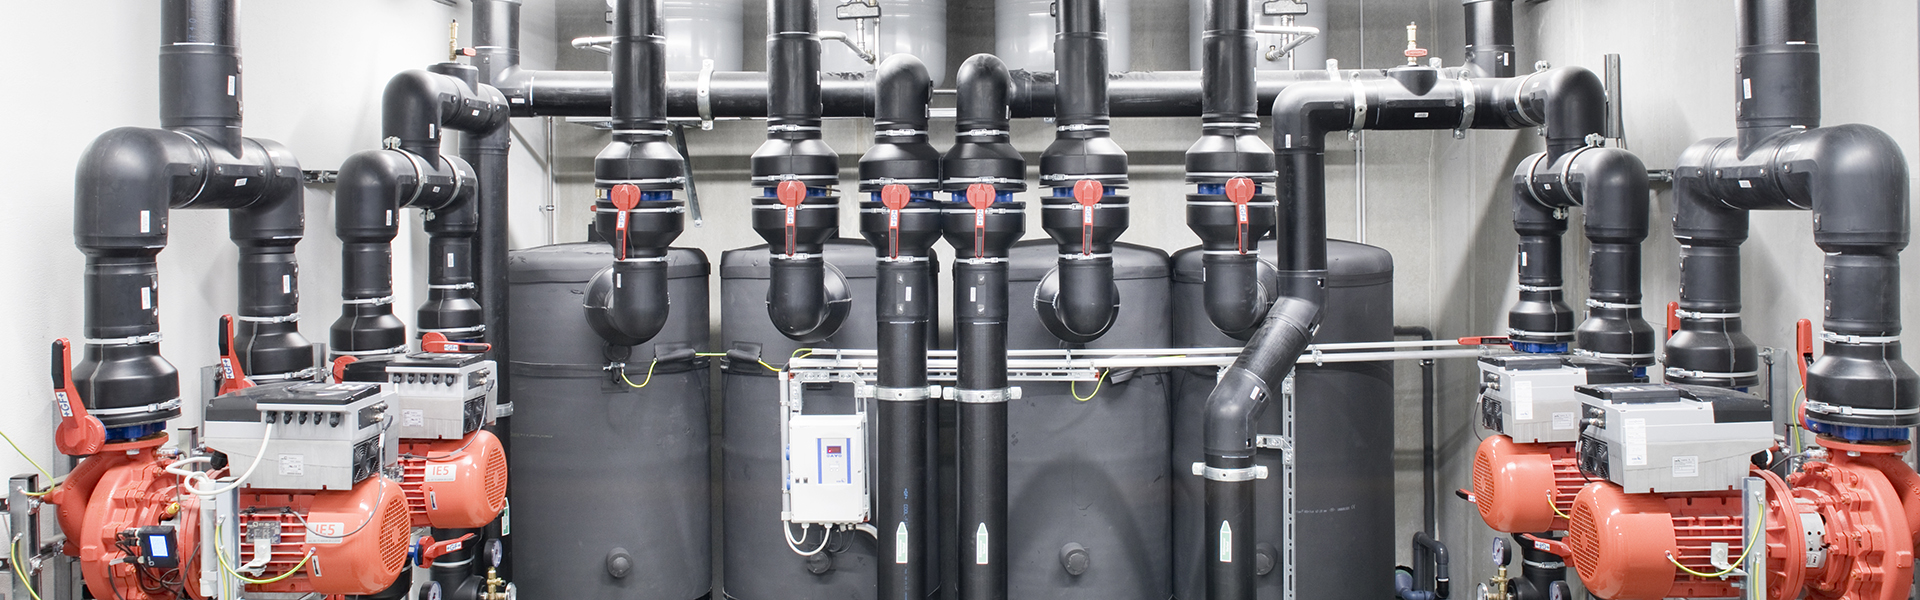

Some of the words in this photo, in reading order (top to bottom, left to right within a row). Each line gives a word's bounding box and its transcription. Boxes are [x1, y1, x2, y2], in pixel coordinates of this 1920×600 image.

[58, 392, 70, 417] +GF+
[432, 465, 450, 476] IE5
[315, 524, 336, 536] IE5
